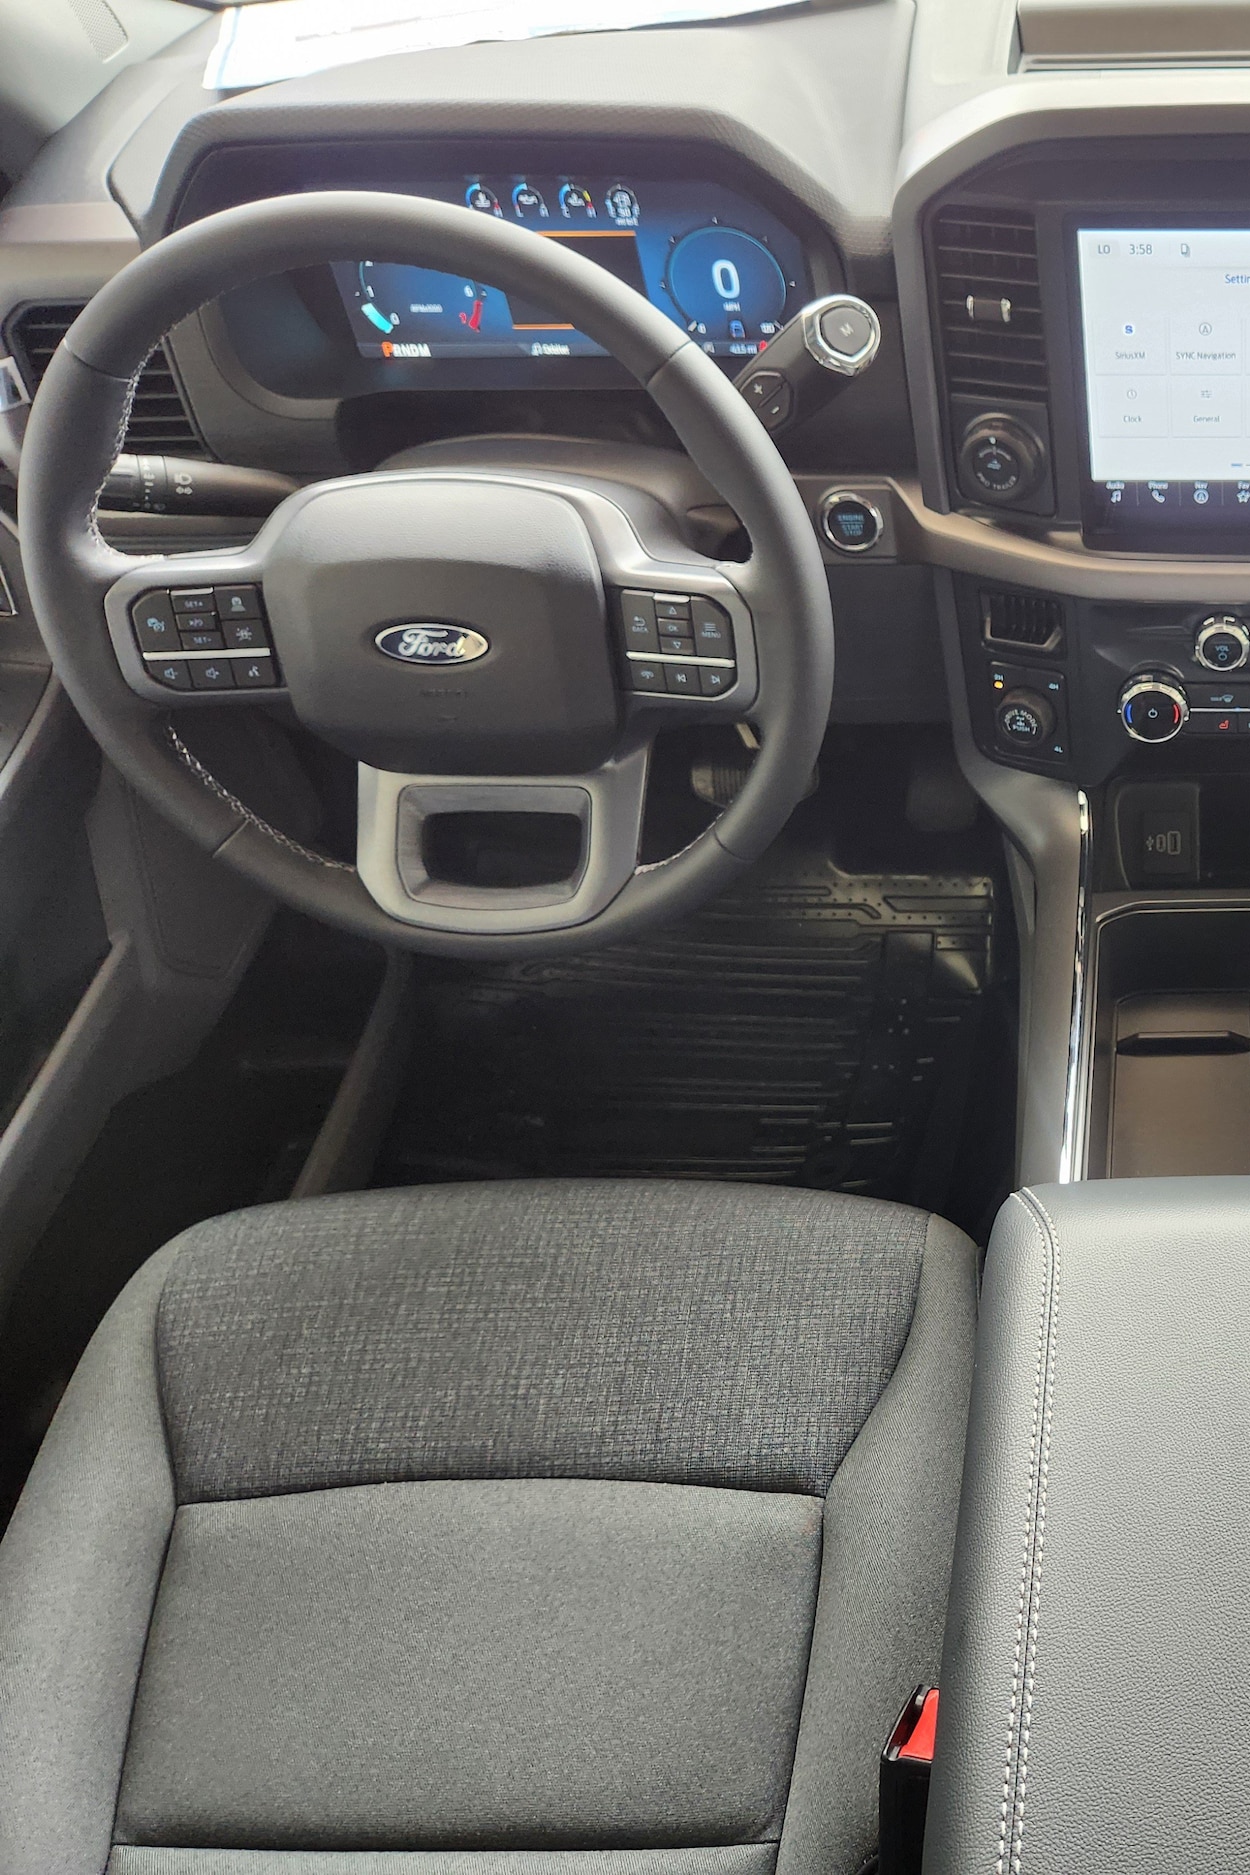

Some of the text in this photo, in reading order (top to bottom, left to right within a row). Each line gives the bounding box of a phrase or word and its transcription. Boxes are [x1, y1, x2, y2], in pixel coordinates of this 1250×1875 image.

[1098, 245, 1111, 254] LO
[1129, 244, 1153, 255] 3:58
[711, 259, 741, 299] 0
[1115, 352, 1146, 360] SiriusXM
[1176, 352, 1236, 361] SYNC Navigation
[1123, 415, 1142, 423] Clock
[1193, 415, 1220, 423] General
[1106, 482, 1125, 490] Audio
[1148, 482, 1168, 490] Phone
[398, 627, 466, 658] Ford
[1012, 724, 1030, 732] PUSH
